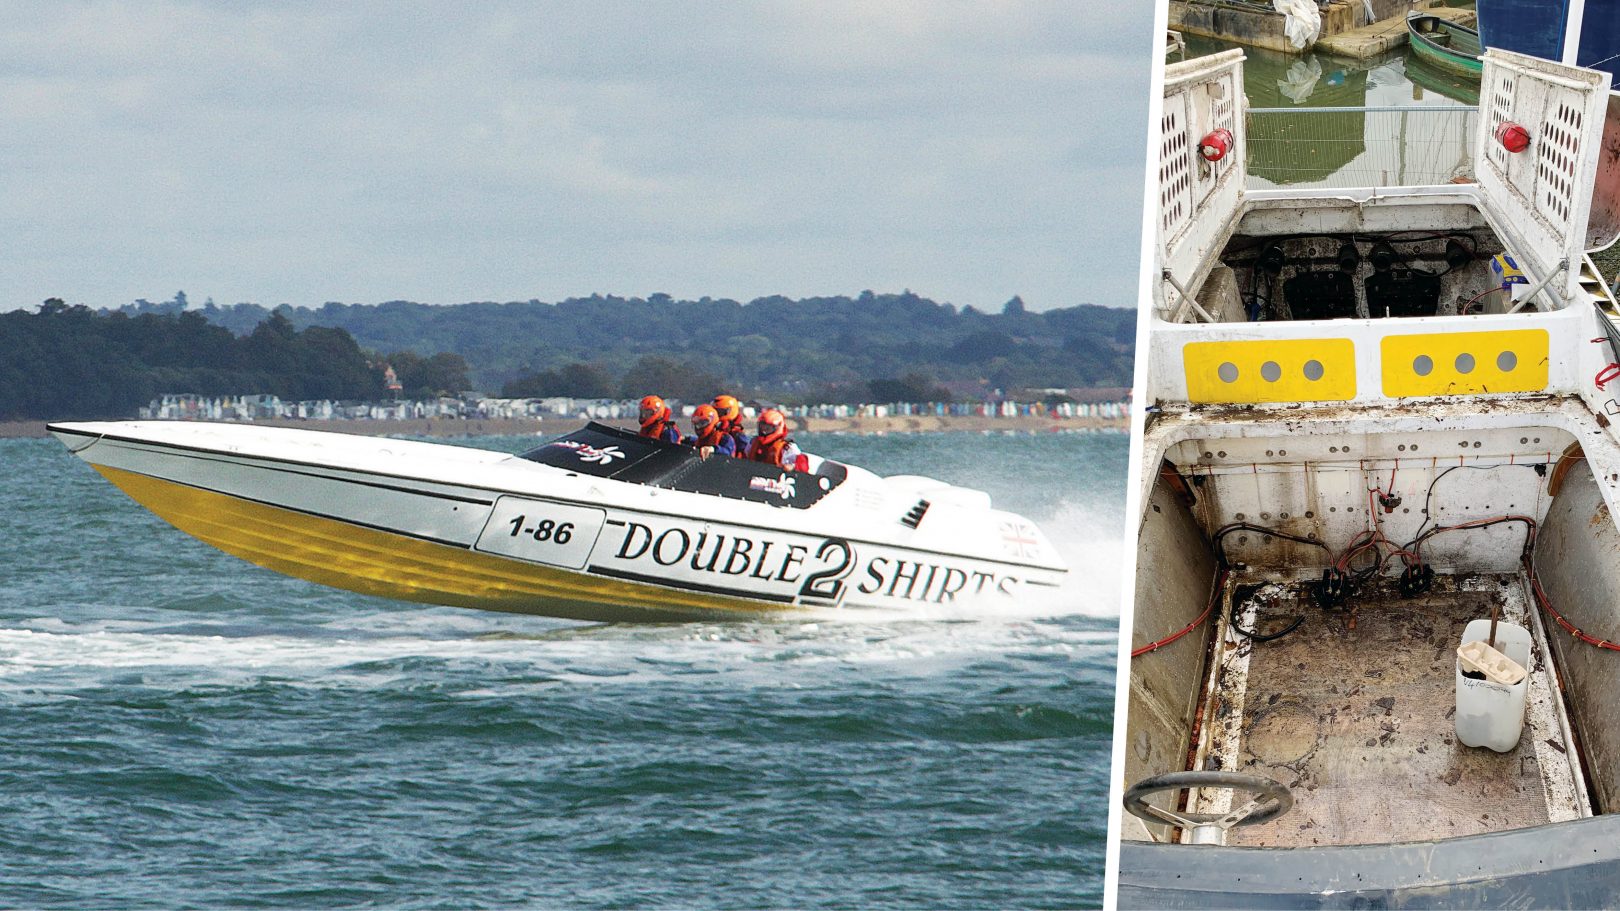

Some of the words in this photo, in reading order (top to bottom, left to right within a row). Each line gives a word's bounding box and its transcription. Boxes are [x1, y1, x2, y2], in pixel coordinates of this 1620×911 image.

[508, 514, 575, 545] 1-86
[614, 521, 808, 583] DOUBLE
[798, 537, 857, 606] 2
